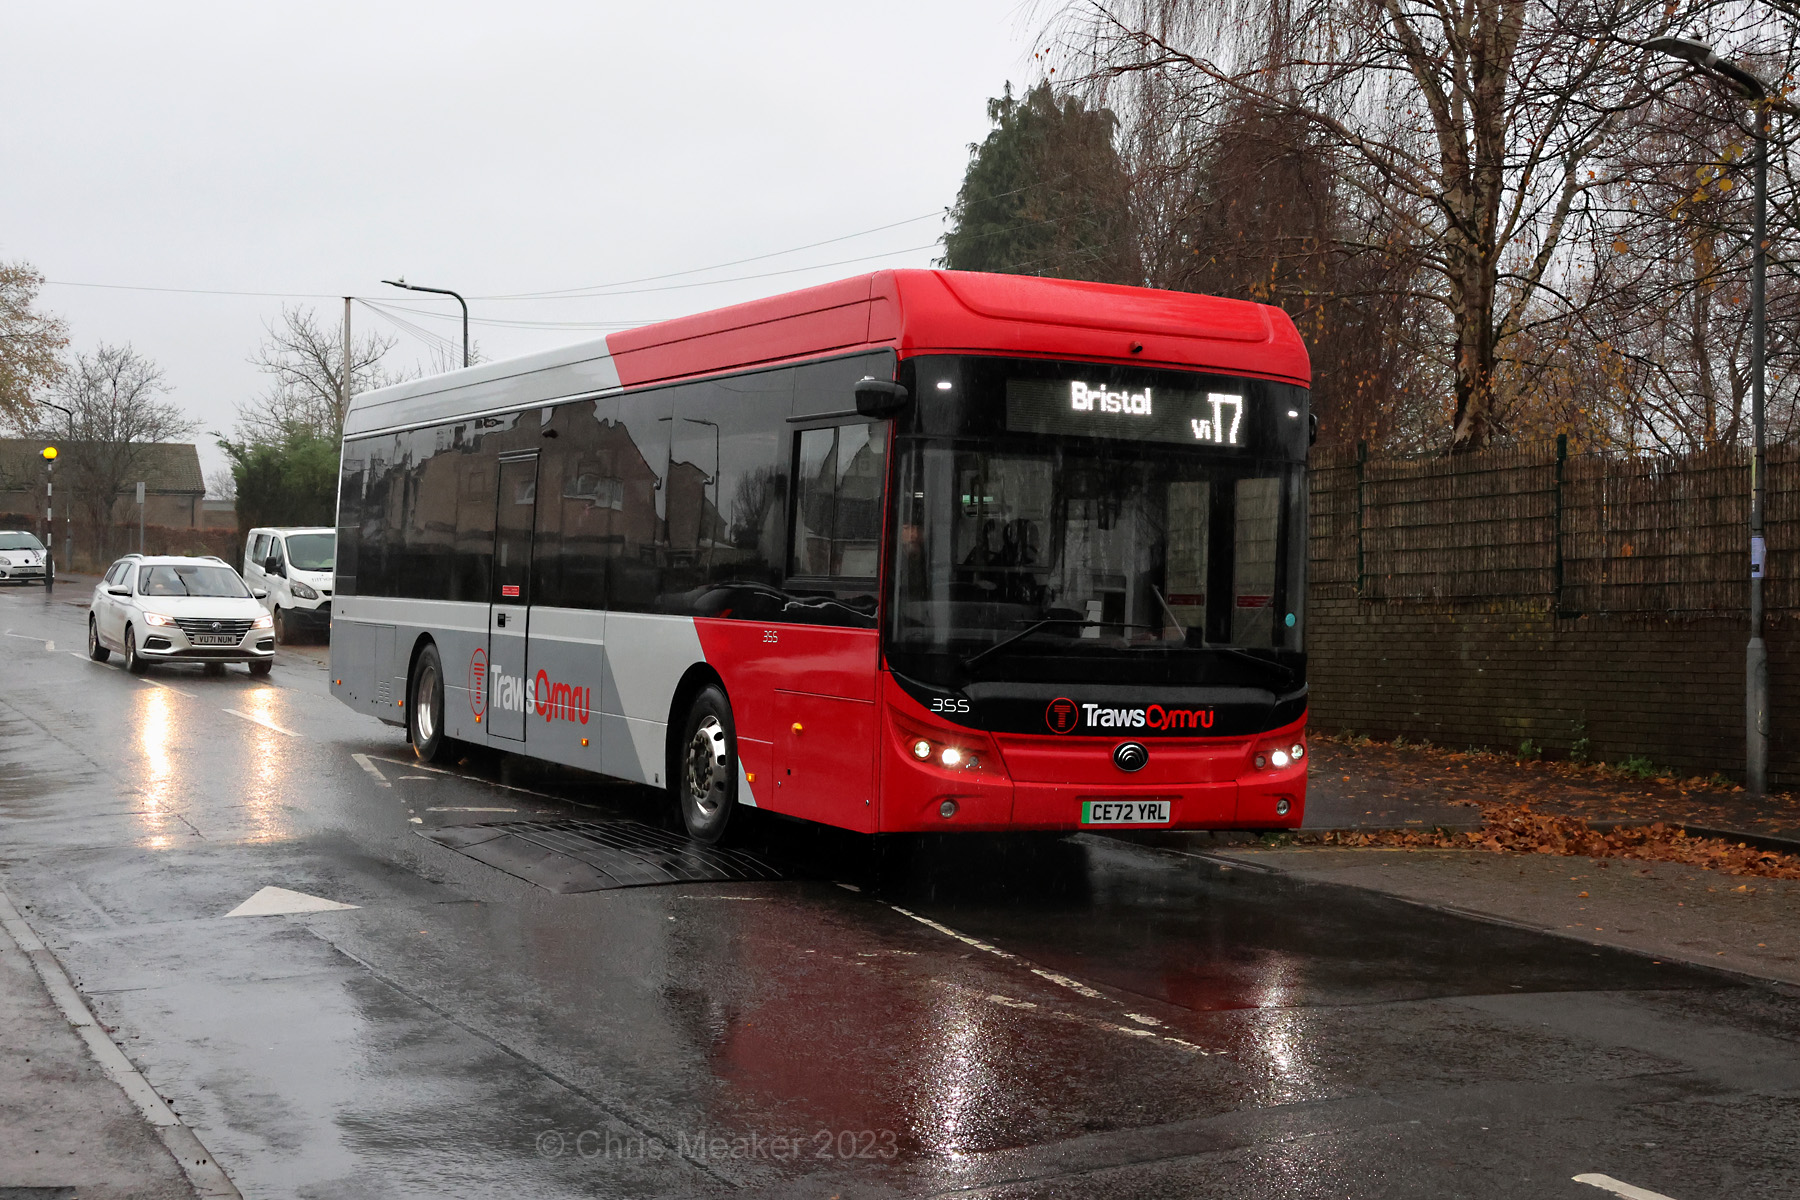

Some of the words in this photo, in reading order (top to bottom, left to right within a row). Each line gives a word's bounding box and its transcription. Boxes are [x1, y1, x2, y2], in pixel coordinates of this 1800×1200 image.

[1071, 380, 1152, 415] Bristol
[1207, 392, 1243, 443] T7
[199, 635, 216, 644] VU71
[217, 635, 233, 644] NUM
[762, 630, 779, 643] 355
[490, 664, 590, 725] TrawsCymru
[930, 697, 970, 713] 355
[1081, 703, 1214, 731] TrawsCymru
[1092, 803, 1134, 821] CE72
[1137, 803, 1167, 821] YRL
